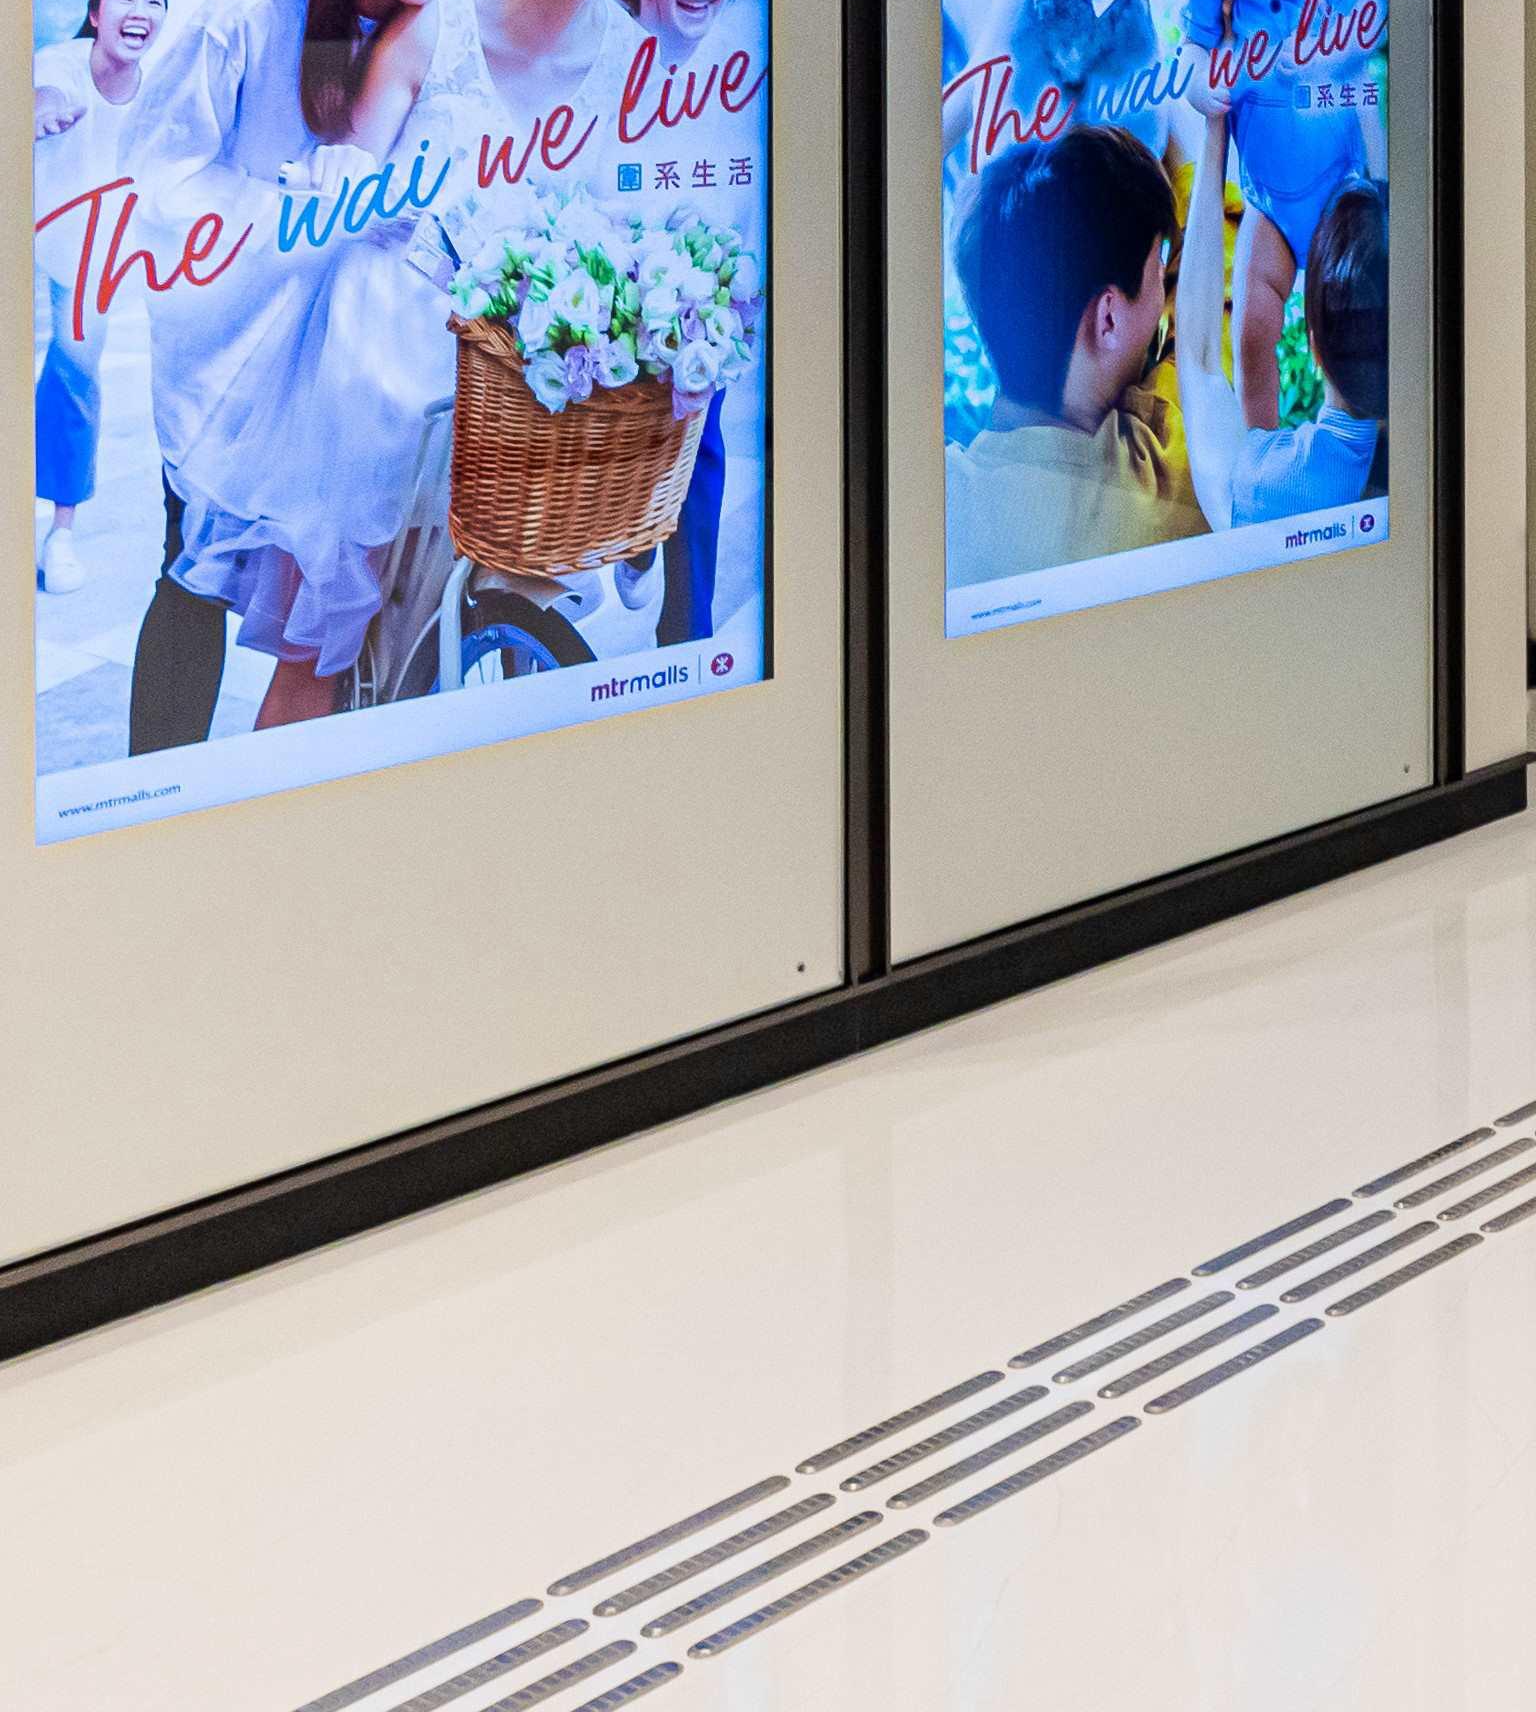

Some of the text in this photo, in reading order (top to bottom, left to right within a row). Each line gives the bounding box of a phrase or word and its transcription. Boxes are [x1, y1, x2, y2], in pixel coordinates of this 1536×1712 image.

[943, 55, 1076, 174] The
[1091, 46, 1195, 124] wai
[1208, 29, 1281, 89] we
[35, 37, 767, 341] The wai we live
[1285, 522, 1347, 549] mtrmalls
[591, 664, 689, 702] mtrmalls
[57, 784, 182, 819] www.mtrmalls.com
